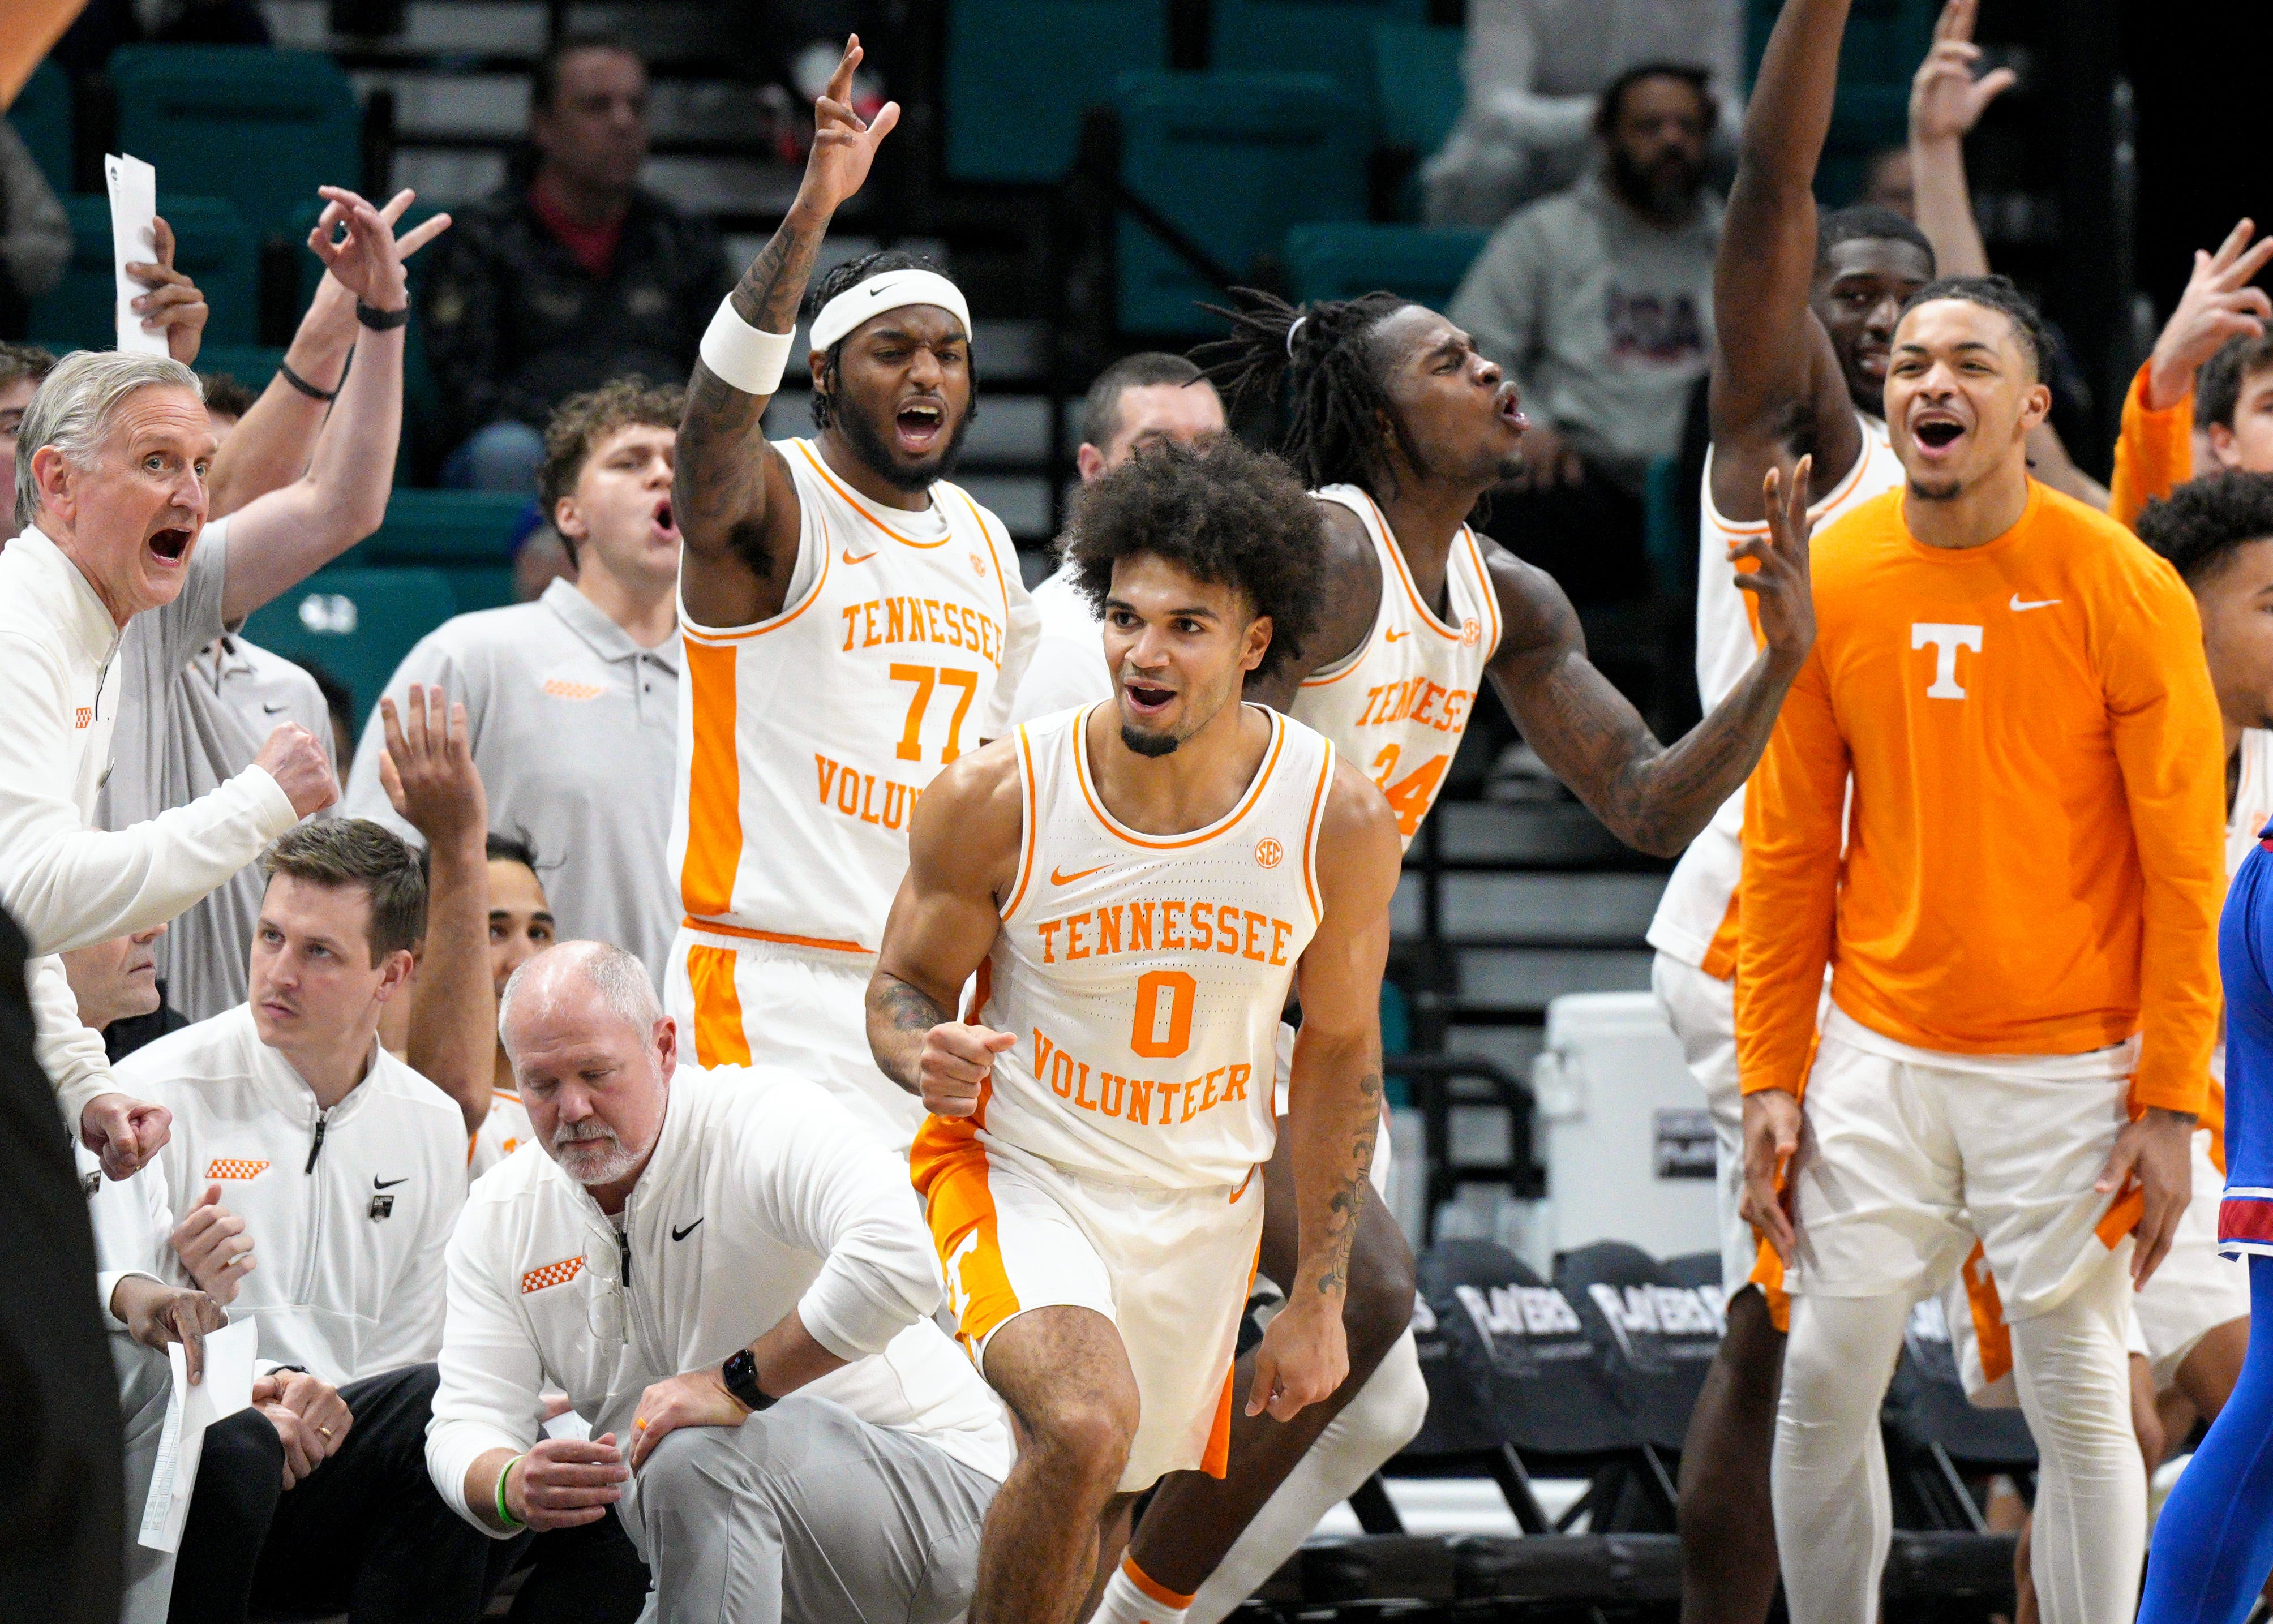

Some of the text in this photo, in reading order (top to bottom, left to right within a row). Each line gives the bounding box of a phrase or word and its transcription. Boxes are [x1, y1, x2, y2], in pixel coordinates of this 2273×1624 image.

[843, 596, 1002, 671] TENNESSEE
[1911, 622, 1983, 699] T
[890, 663, 978, 764] 77
[1373, 743, 1449, 836] 24
[1258, 841, 1280, 866] SEC
[1039, 901, 1292, 966] TENNESSEE
[1131, 970, 1197, 1059] 0
[1033, 1026, 1252, 1125] VOLUNTEER
